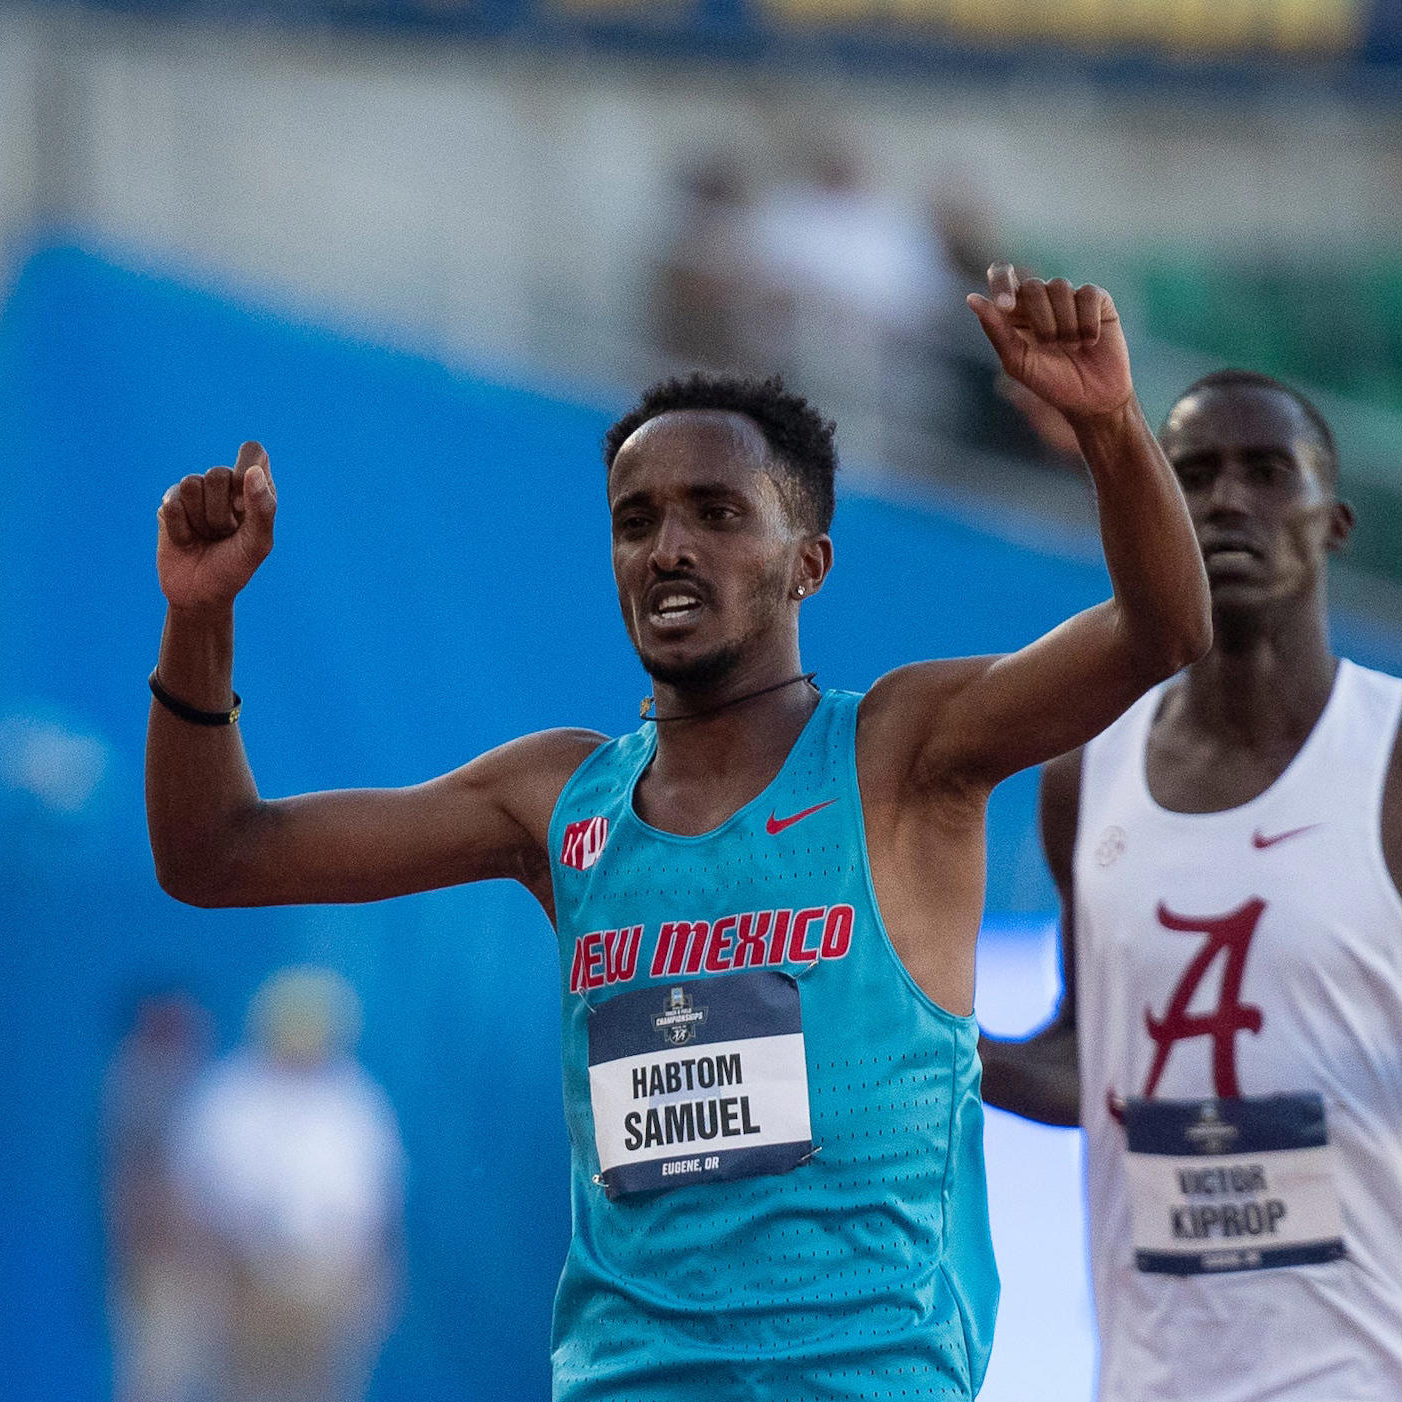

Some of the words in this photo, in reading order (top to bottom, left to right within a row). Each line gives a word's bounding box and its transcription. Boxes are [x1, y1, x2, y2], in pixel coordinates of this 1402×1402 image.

[649, 904, 855, 978] MEXICO
[632, 1053, 743, 1099] HABTOM
[624, 1096, 761, 1151] SAMUEL
[662, 1159, 702, 1176] EUGENE,
[704, 1156, 719, 1170] OR
[1170, 1199, 1287, 1239] KIPROP
